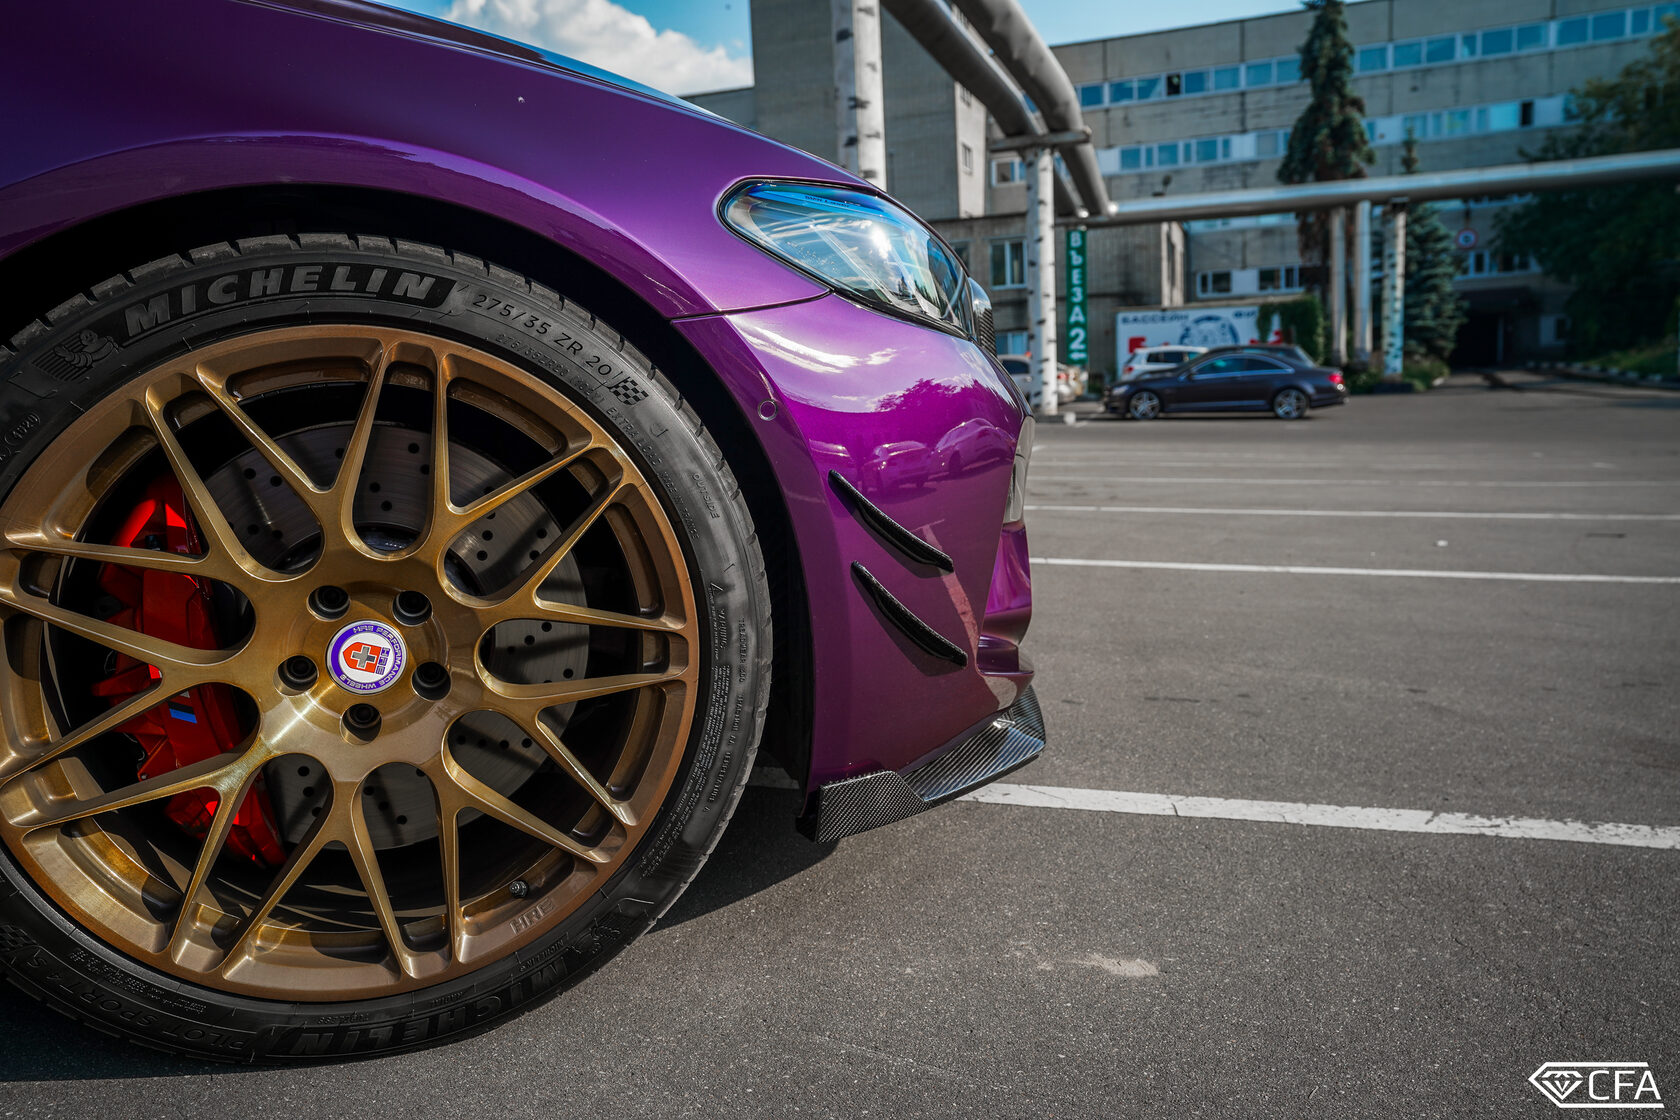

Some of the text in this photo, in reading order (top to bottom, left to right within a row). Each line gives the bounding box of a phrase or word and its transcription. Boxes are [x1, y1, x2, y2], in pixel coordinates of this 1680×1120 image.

[125, 266, 436, 337] MICHELIN
[473, 294, 612, 376] 275/35 ZR 20
[606, 408, 639, 438] EXTRA
[691, 472, 720, 519] OUTSIDE
[376, 627, 402, 686] PERFORMANCE
[376, 647, 391, 676] HRE
[339, 674, 377, 690] WHEELS
[509, 897, 555, 936] HRE
[59, 983, 158, 1027] SPORT
[290, 957, 568, 1054] MICHELIN
[163, 1026, 250, 1051] PILOT
